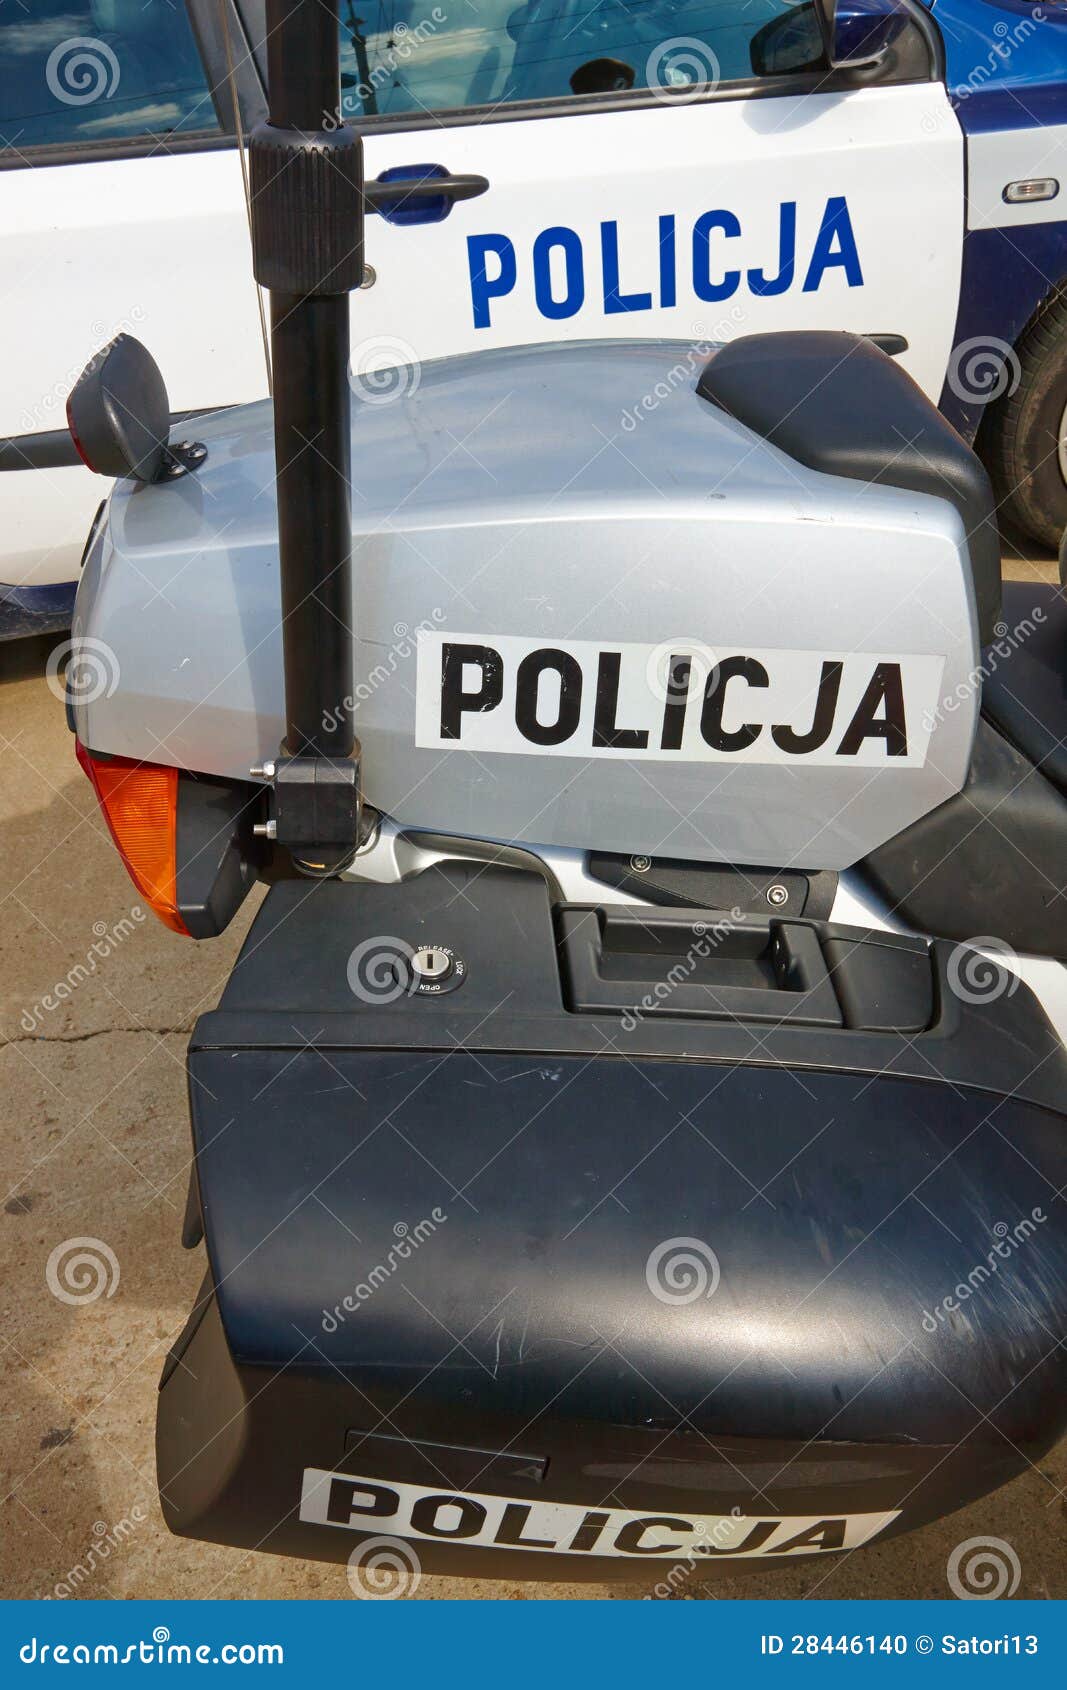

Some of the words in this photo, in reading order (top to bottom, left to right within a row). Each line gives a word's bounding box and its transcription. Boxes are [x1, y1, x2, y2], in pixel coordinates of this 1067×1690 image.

[466, 196, 864, 330] POLICJA
[440, 643, 908, 757] POLICJA
[327, 1478, 848, 1556] POLICJA
